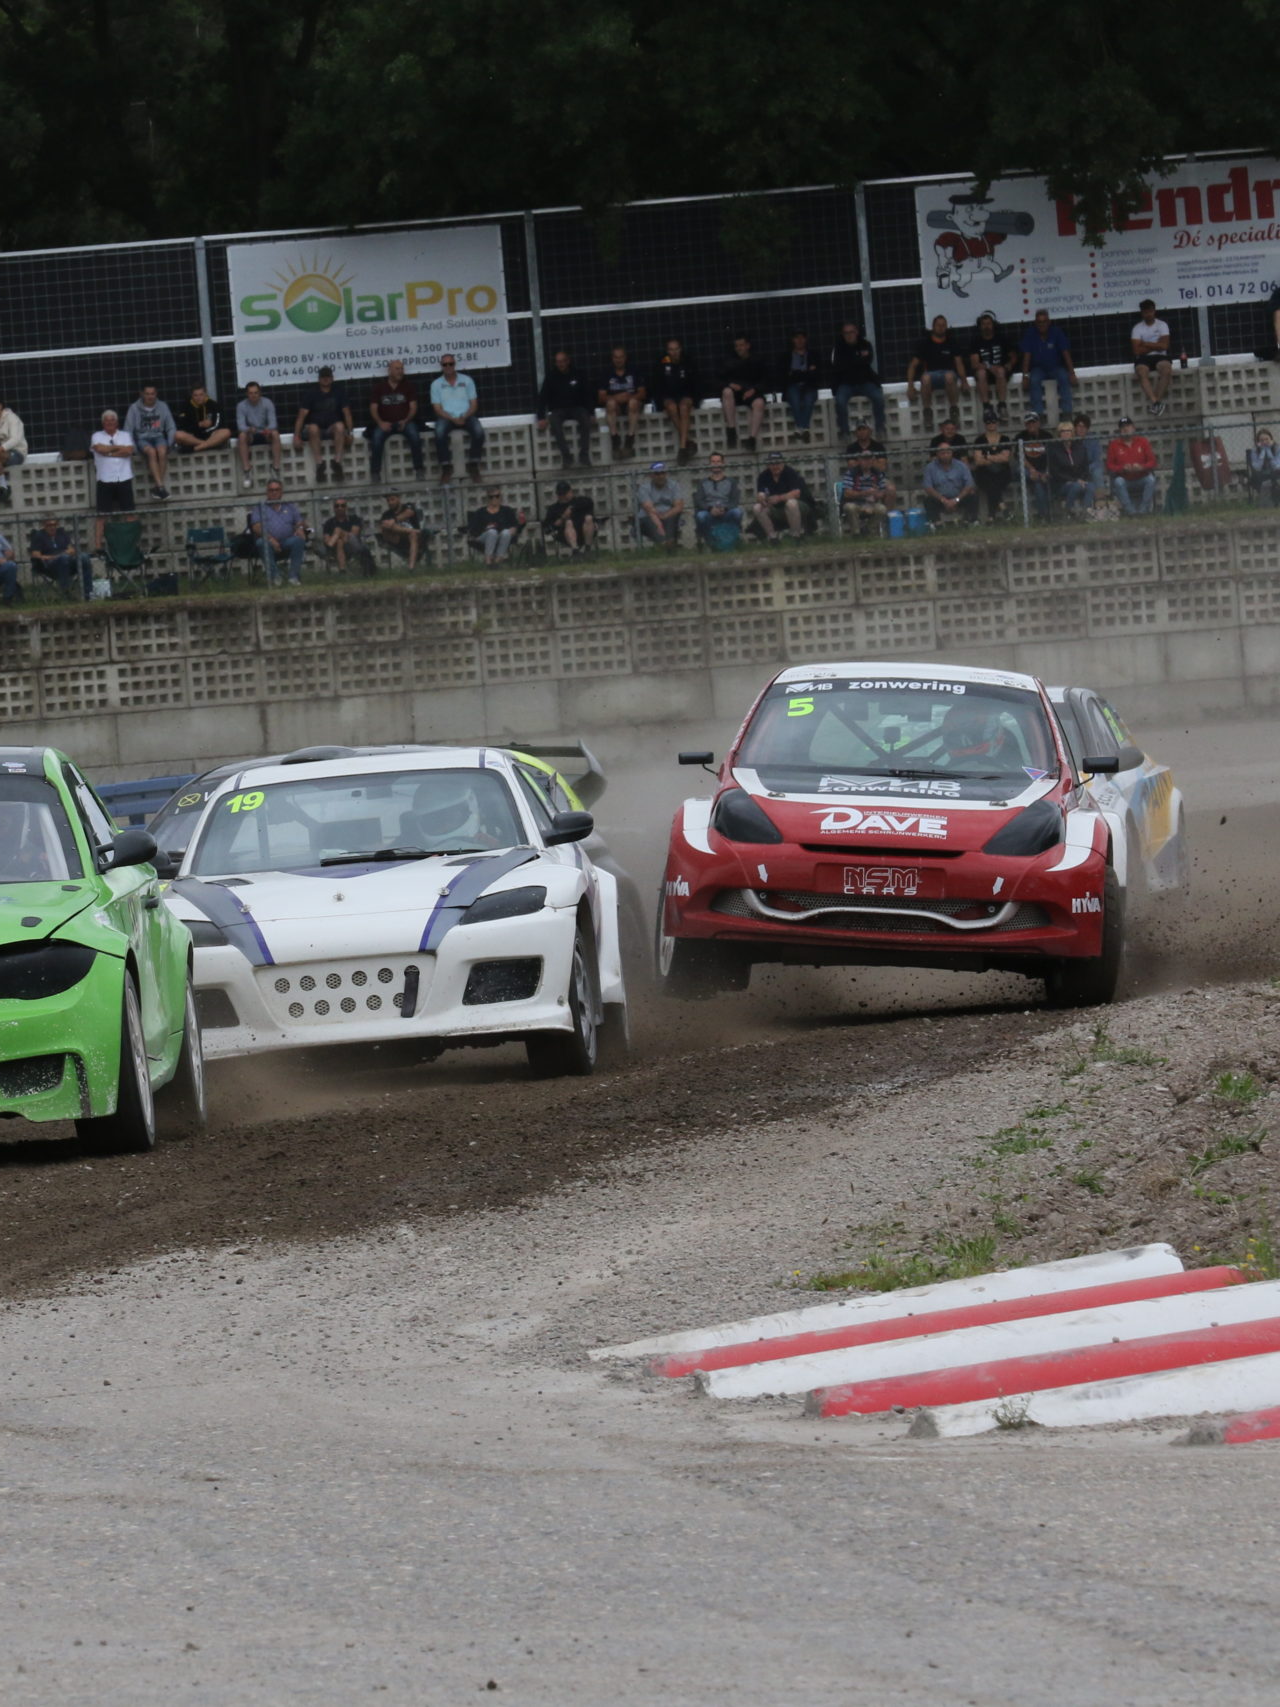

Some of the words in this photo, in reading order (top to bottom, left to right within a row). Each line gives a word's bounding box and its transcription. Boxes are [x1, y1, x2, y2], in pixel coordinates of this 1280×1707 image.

[1173, 229, 1201, 249] Dé
[1178, 287, 1201, 300] Tel.
[1207, 284, 1233, 297] 014
[1238, 281, 1255, 294] 72
[346, 327, 367, 337] Eco
[371, 323, 418, 336] Systems
[420, 319, 443, 331] And
[447, 316, 498, 329] Solutions
[245, 354, 297, 367] SOLARPRO
[301, 354, 314, 363] BV
[445, 338, 500, 350] TURNHOUT
[269, 367, 289, 377] 014
[292, 366, 304, 375] 46
[848, 680, 966, 695] zonwering
[787, 697, 815, 717] 5
[818, 786, 961, 798] ZONWERING
[226, 791, 265, 814] 19
[809, 806, 948, 835] DAVE
[843, 866, 918, 889] NSM
[843, 886, 918, 896] CARS
[1071, 891, 1101, 914] HYVA
